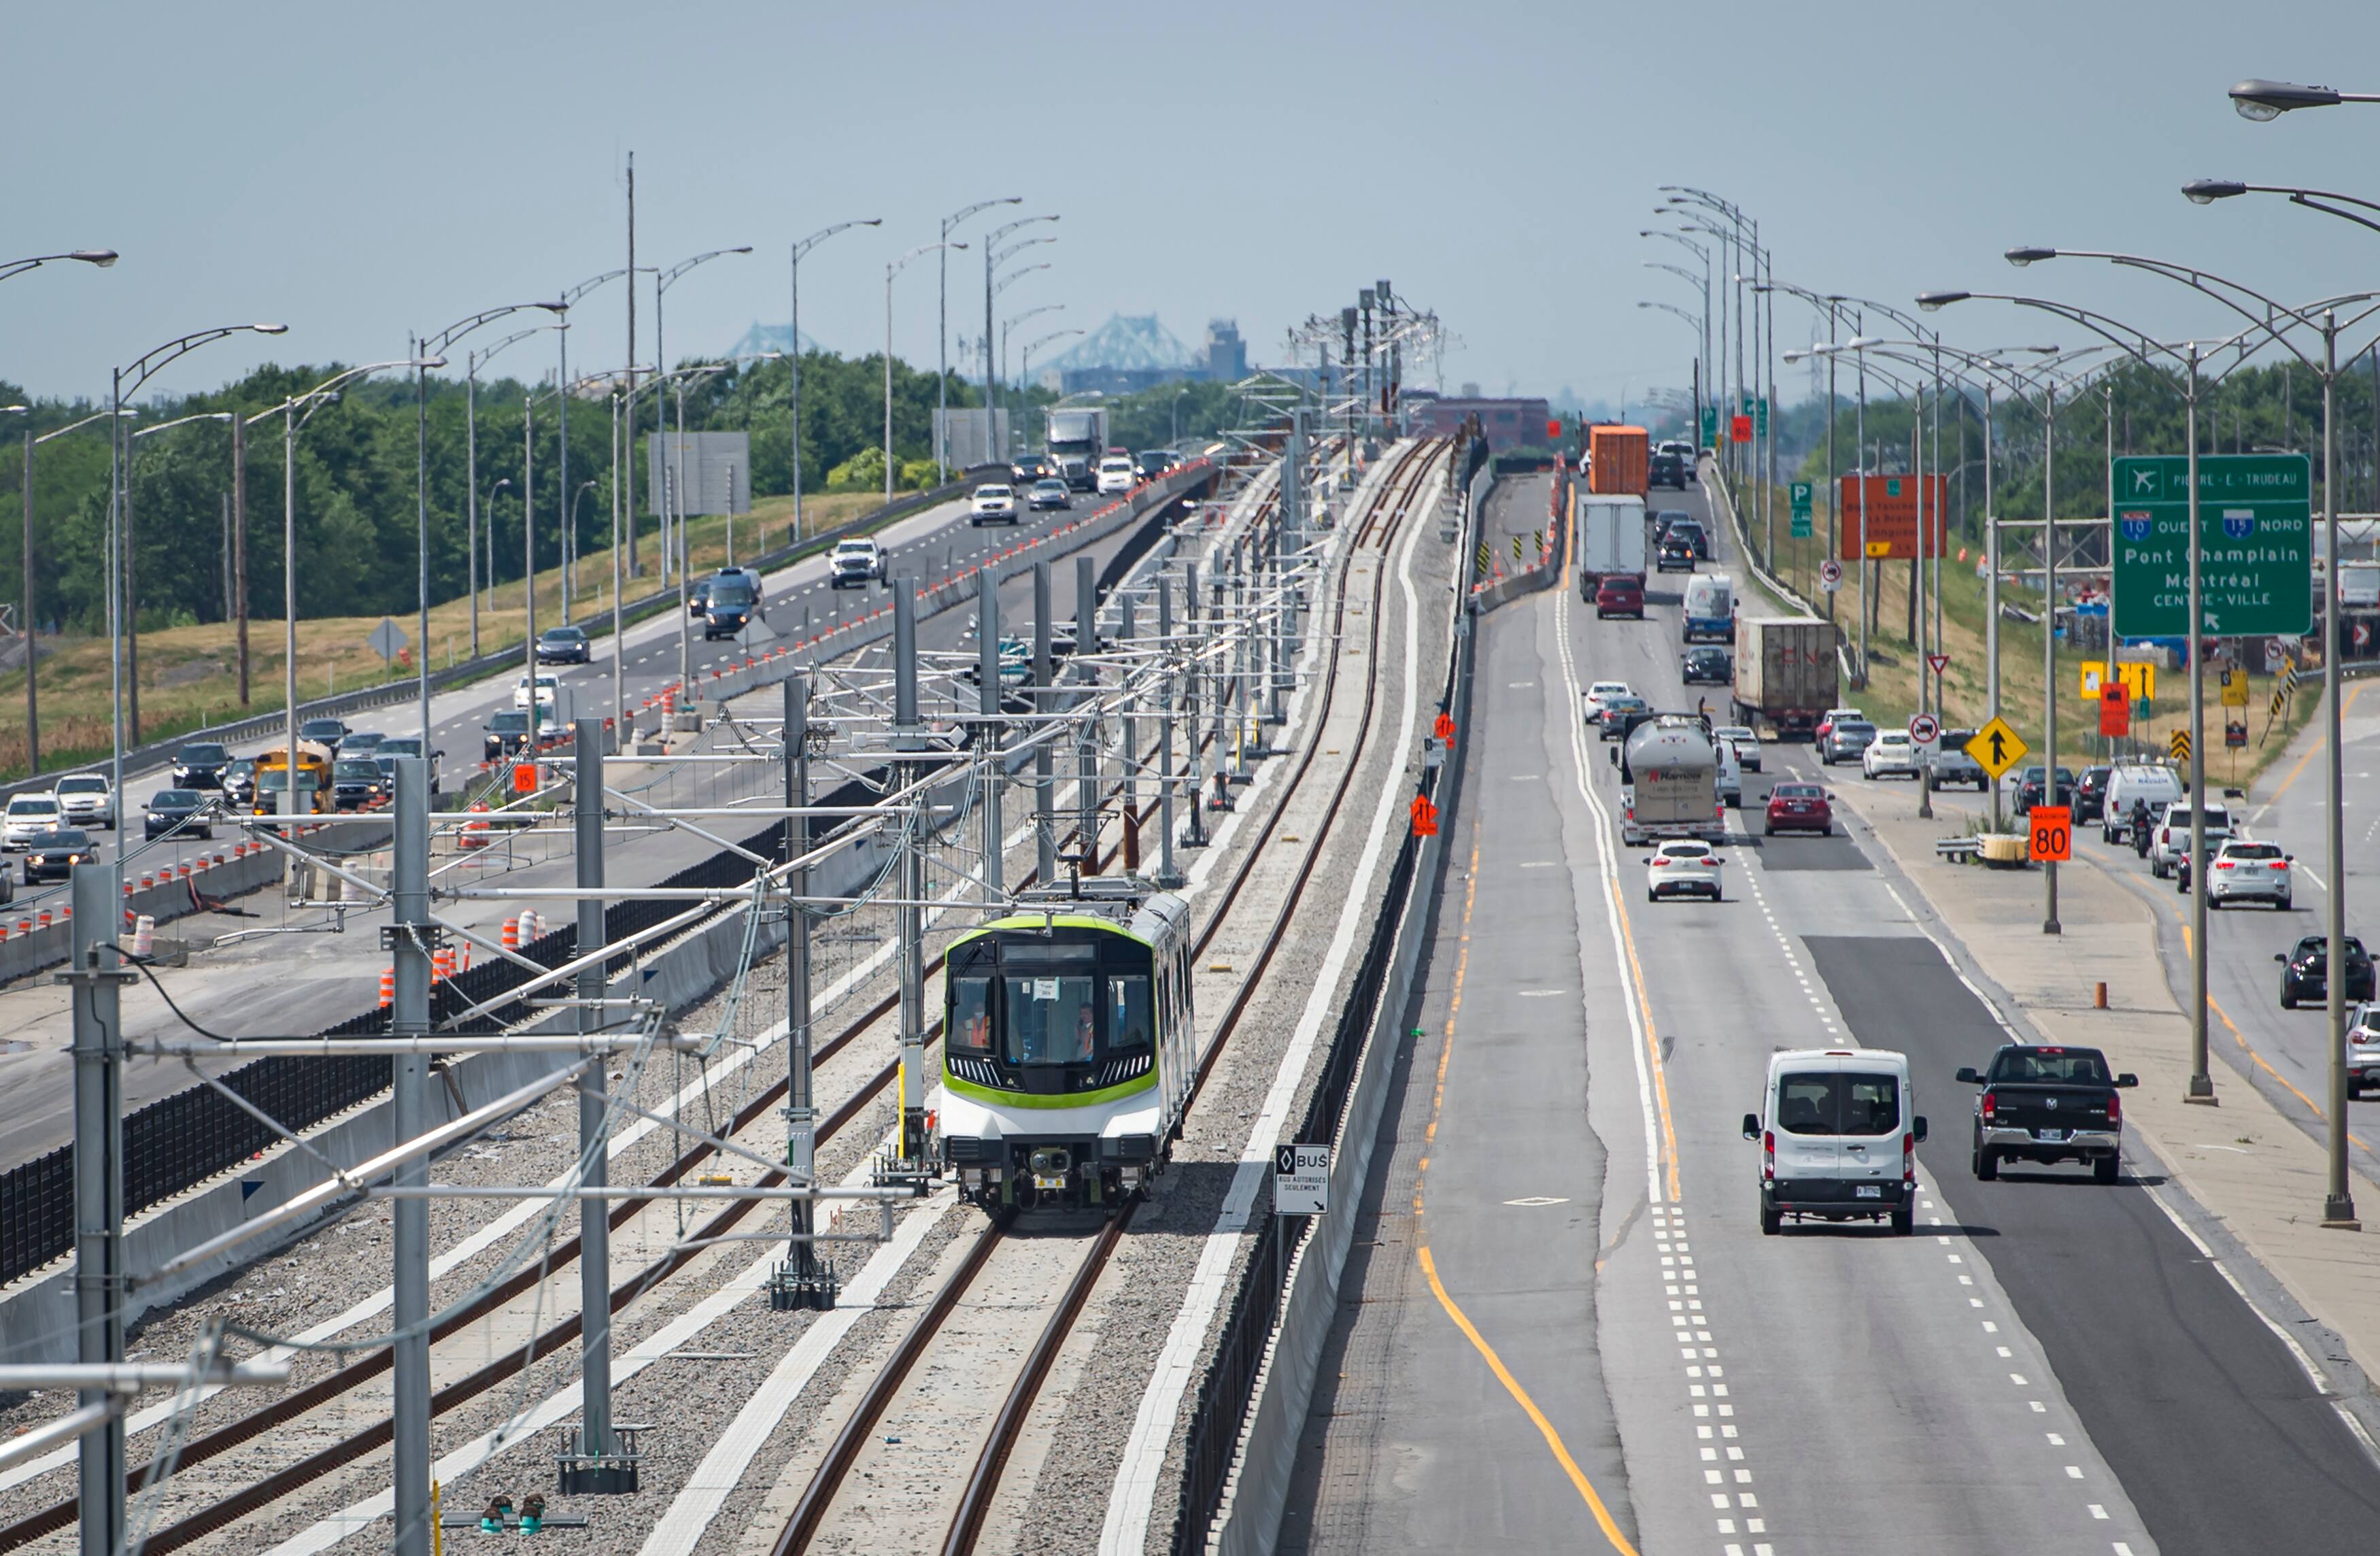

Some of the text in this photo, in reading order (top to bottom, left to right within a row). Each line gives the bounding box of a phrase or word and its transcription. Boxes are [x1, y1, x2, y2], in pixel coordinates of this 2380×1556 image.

[2174, 474, 2214, 486] PIERE
[2247, 473, 2296, 486] TRUDEAU
[2129, 519, 2303, 533] 10 OUET 15 NORD
[2124, 547, 2298, 564] Pont Champlain
[2165, 573, 2260, 588] Montréal
[520, 773, 531, 787] 15
[2036, 827, 2067, 854] 80
[1297, 1155, 1328, 1168] BUS
